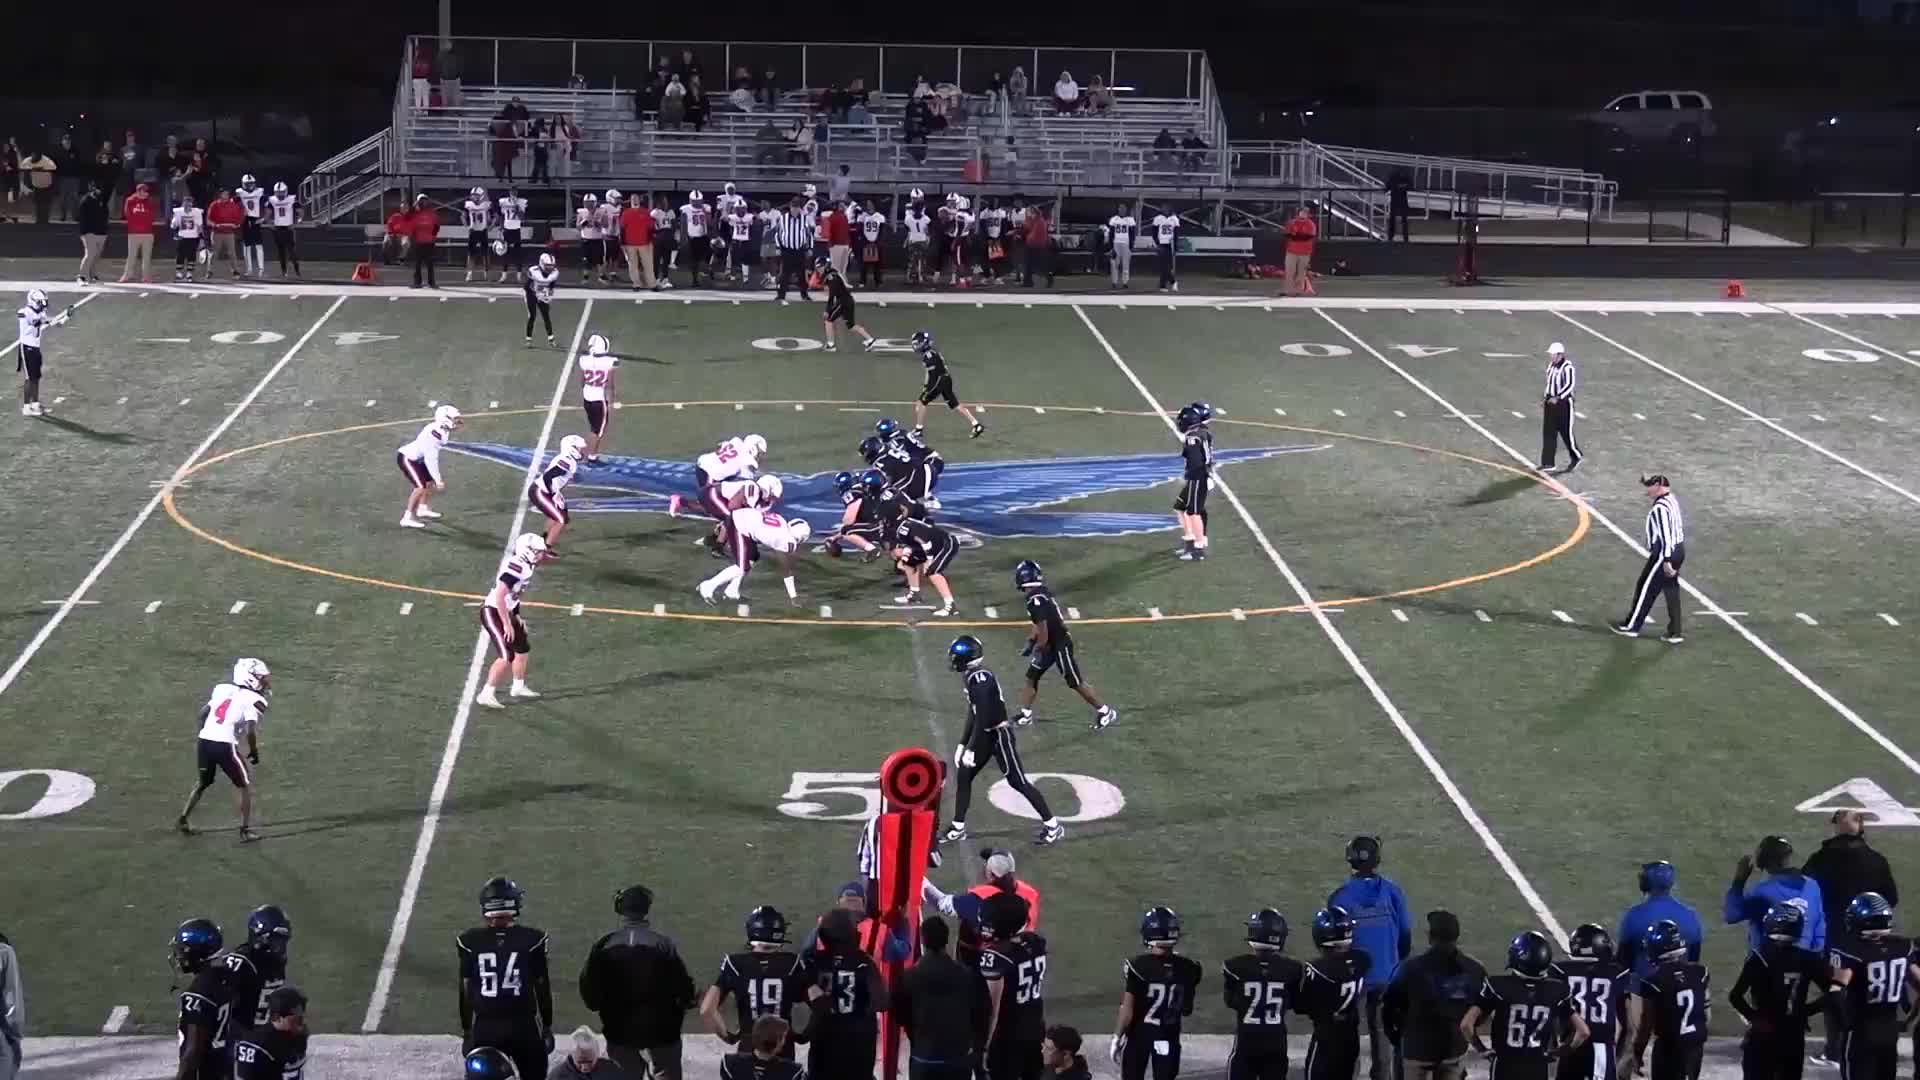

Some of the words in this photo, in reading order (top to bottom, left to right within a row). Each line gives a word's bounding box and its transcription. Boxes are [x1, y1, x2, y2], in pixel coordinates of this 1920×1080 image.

[584, 369, 606, 387] 22
[214, 698, 232, 725] 4
[776, 772, 1126, 822] 50
[226, 956, 243, 972] 57
[477, 952, 522, 997] 64
[1015, 955, 1047, 1004] 53
[1867, 956, 1908, 1004] 80
[747, 978, 783, 1019] 19
[1243, 981, 1285, 1025] 25
[1567, 975, 1613, 1025] 33
[1676, 989, 1697, 1035] 2
[1507, 1003, 1551, 1048] 62
[238, 1046, 256, 1063] 58
